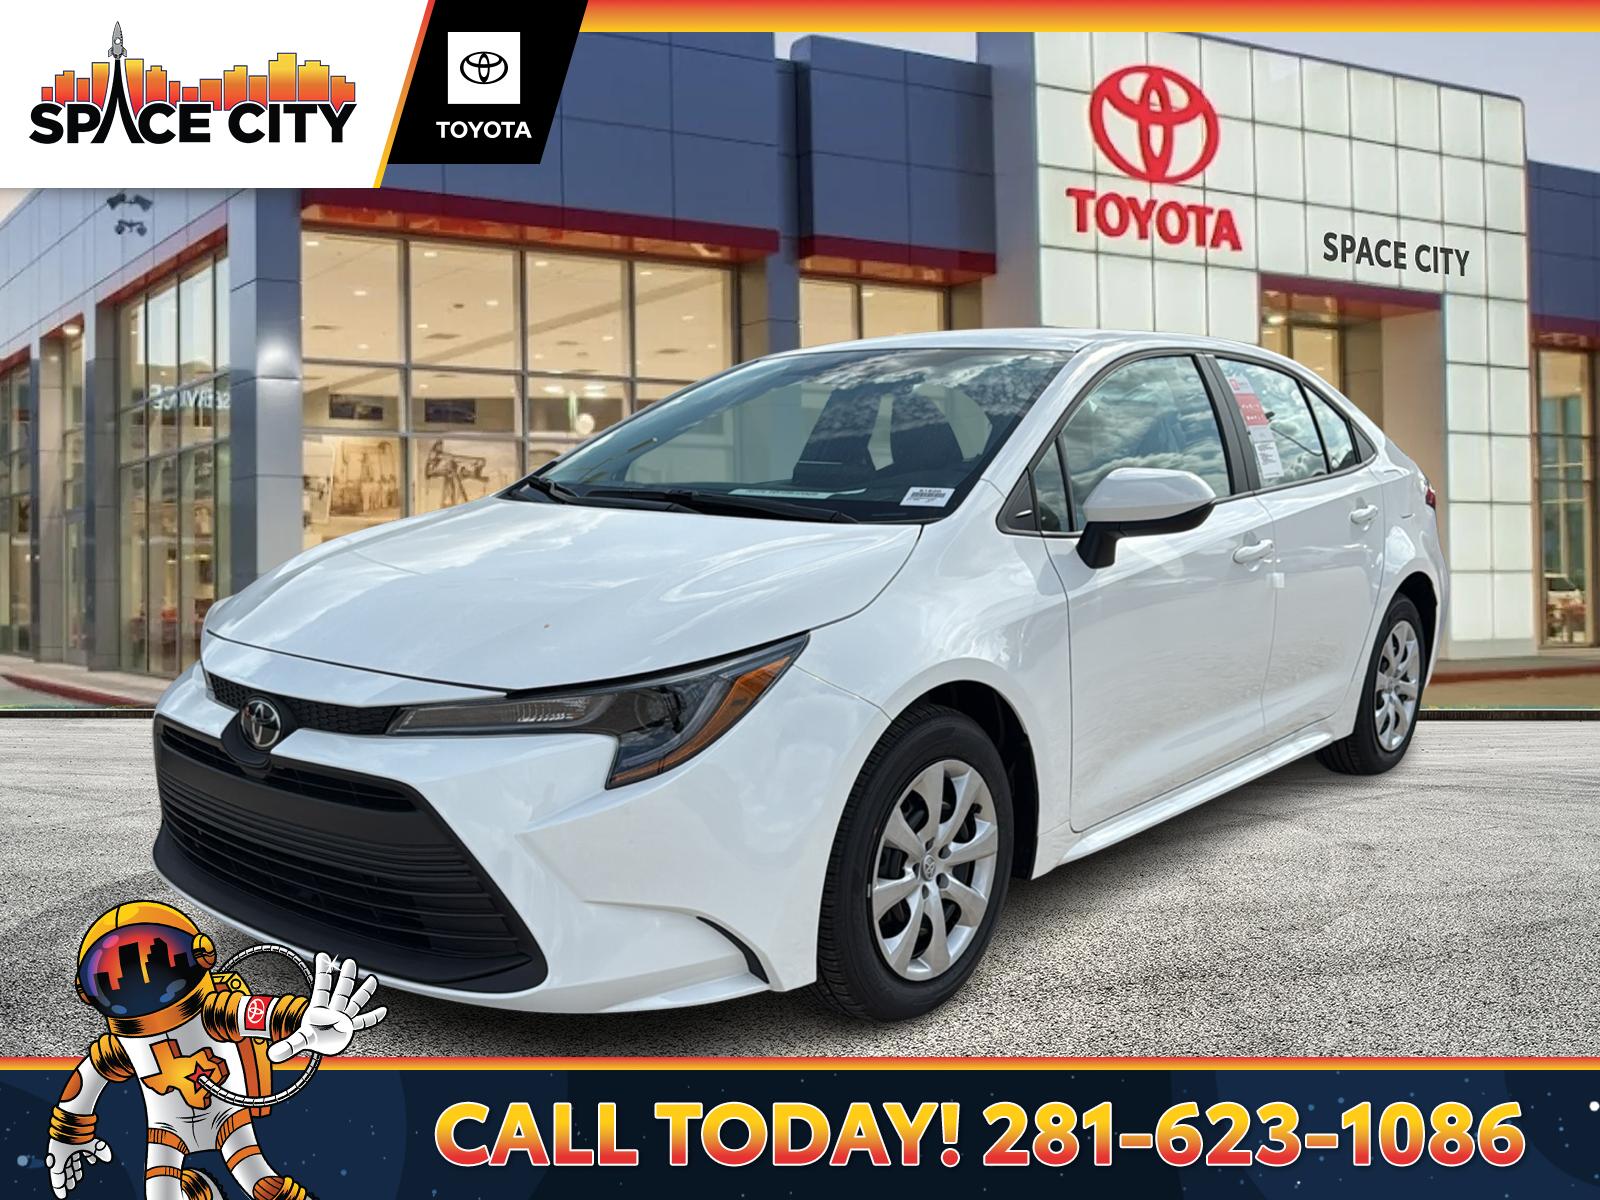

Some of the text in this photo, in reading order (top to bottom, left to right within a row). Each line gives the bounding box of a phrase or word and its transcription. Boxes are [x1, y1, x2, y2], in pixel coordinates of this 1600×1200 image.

[1066, 188, 1242, 251] TOYOTA
[1323, 231, 1471, 277] SPACE CITY
